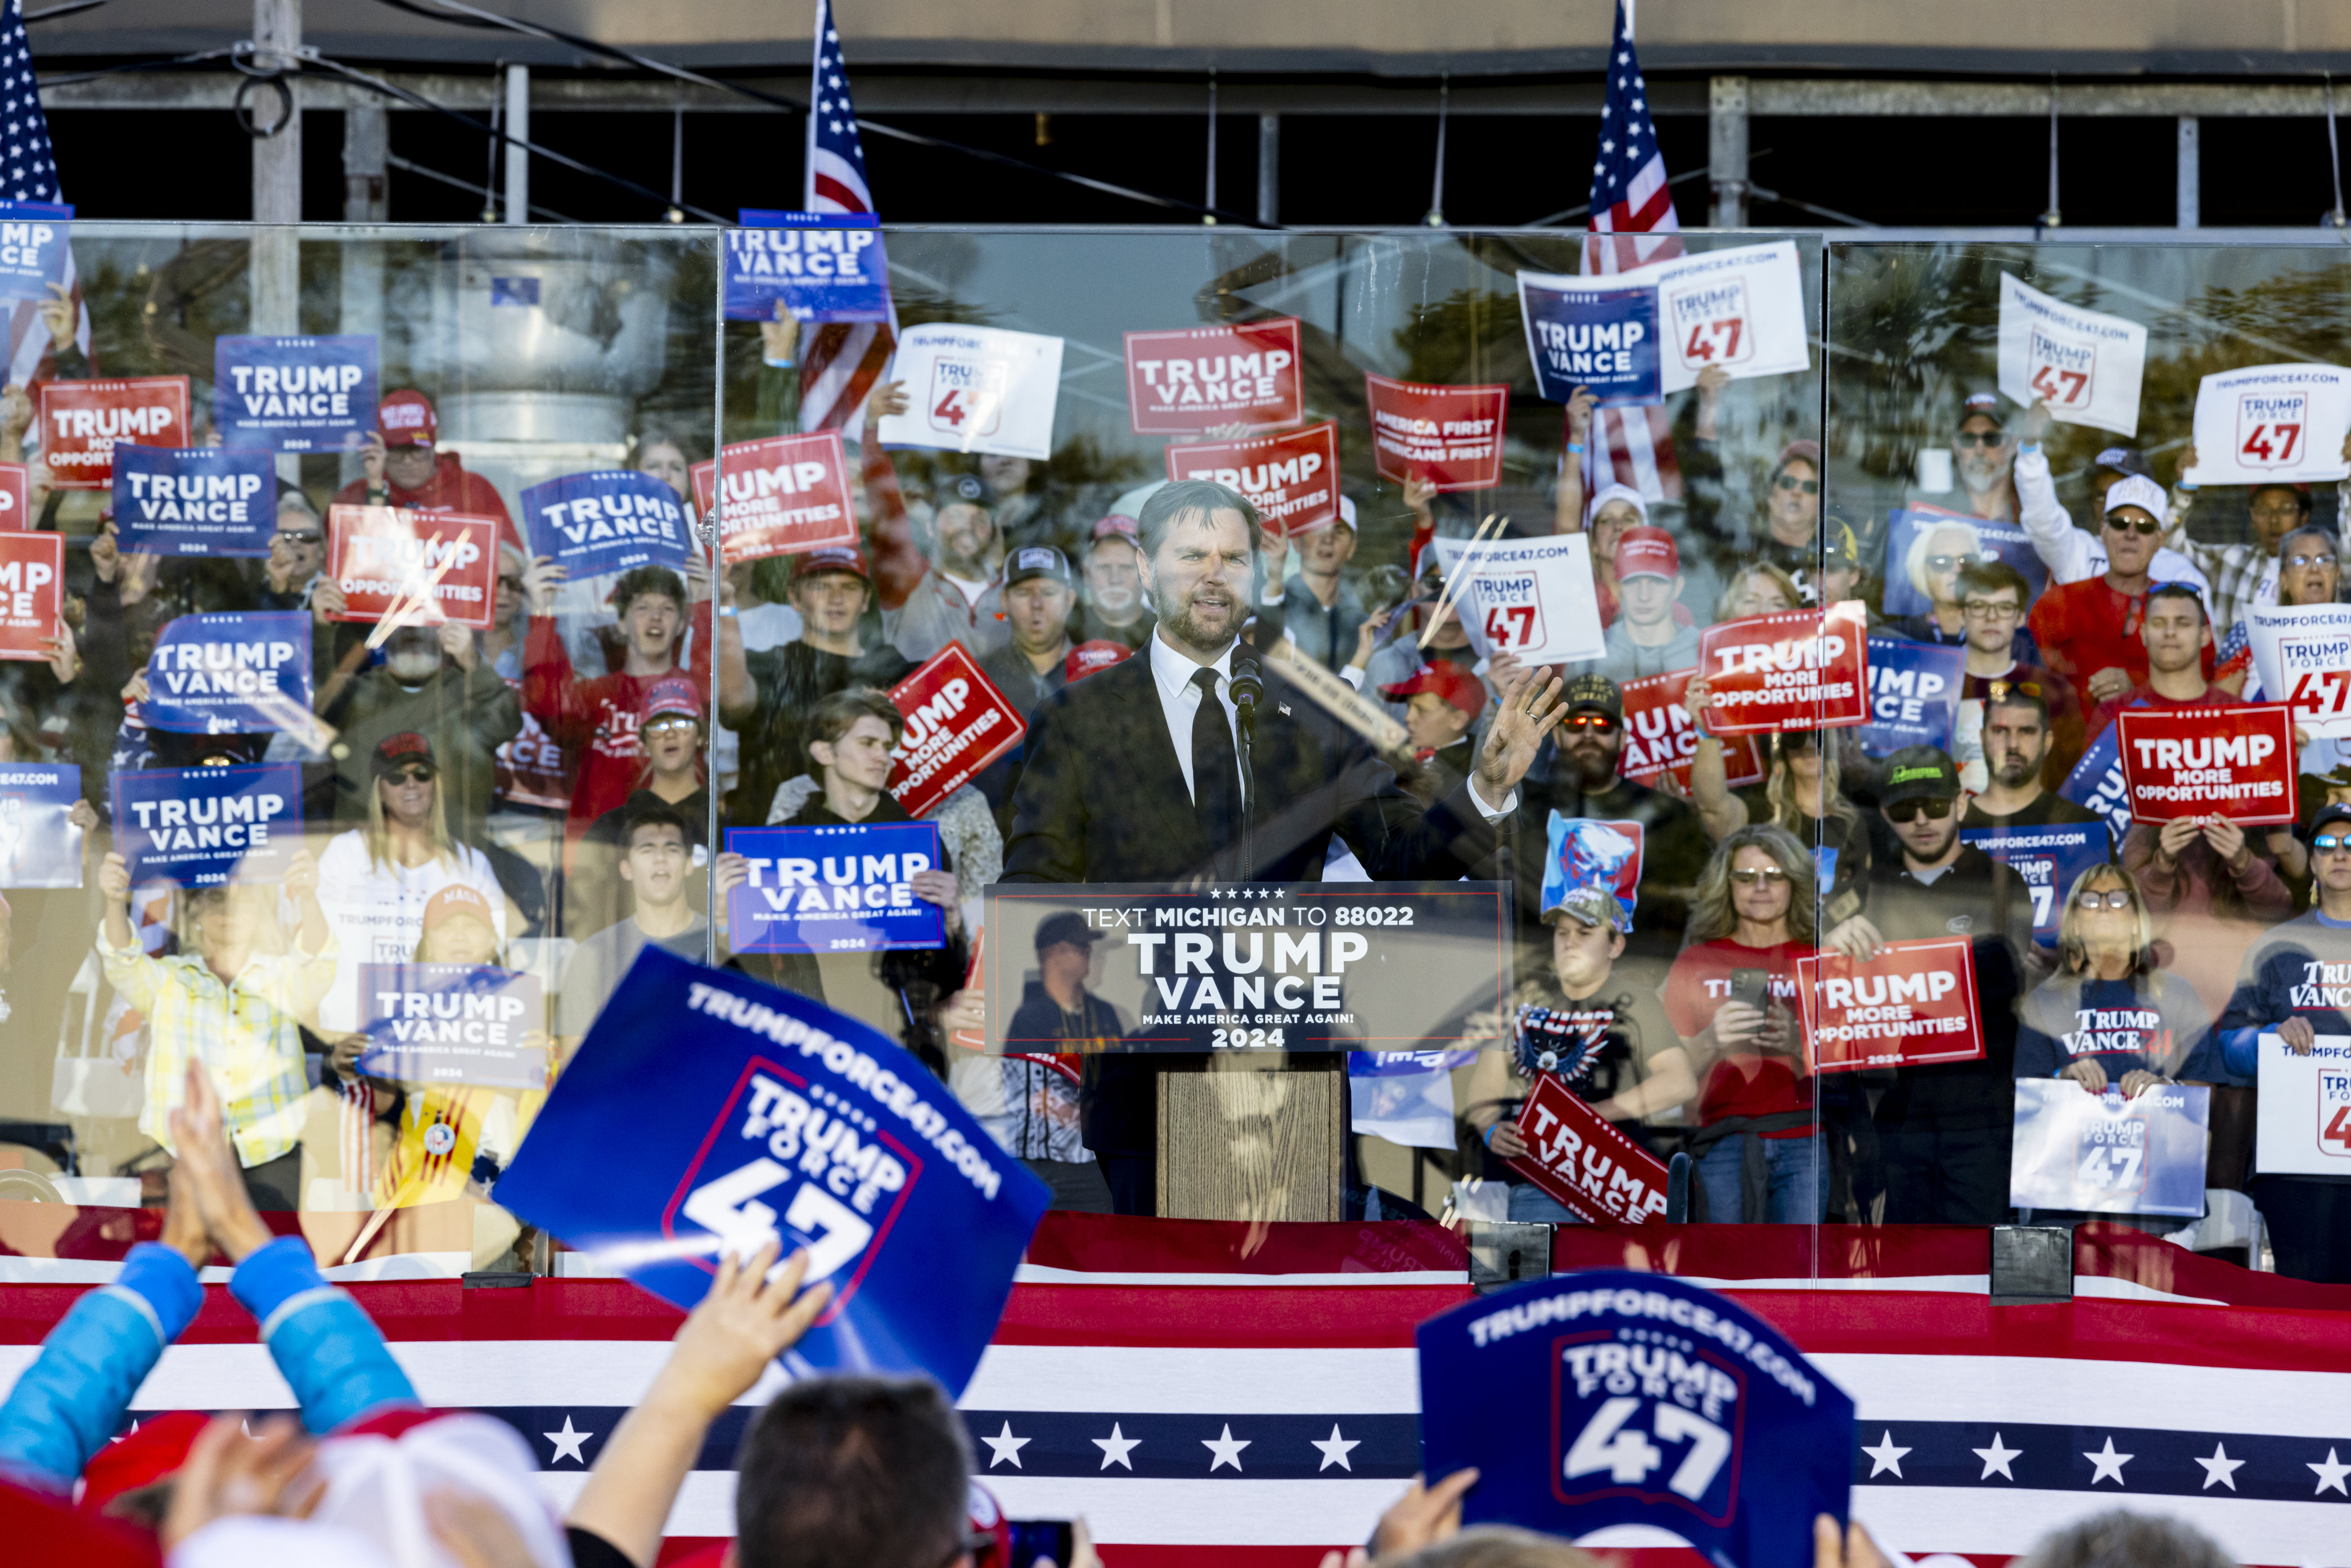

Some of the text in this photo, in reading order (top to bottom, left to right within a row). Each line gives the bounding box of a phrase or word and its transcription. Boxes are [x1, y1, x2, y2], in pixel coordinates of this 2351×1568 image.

[728, 229, 874, 253] TRUMP
[737, 252, 861, 275] VANCE
[1676, 284, 1740, 312] TRUMP
[1680, 301, 1737, 322] FORCE
[1535, 319, 1645, 353] TRUMP
[1687, 317, 1743, 361] 47
[2034, 333, 2092, 362] TRUMP
[1136, 350, 1292, 386] TRUMP
[1547, 349, 1632, 373] VANCE
[2035, 351, 2086, 369] FORCE
[231, 364, 363, 395] TRUMP
[1156, 377, 1276, 404] VANCE
[2030, 365, 2088, 403] 47
[244, 394, 349, 417] VANCE
[1177, 402, 1219, 412] AMERICA
[1222, 399, 1251, 410] GREAT
[1253, 395, 1285, 407] AGAIN!
[2244, 396, 2303, 412] TRUMP
[2246, 411, 2298, 421] FORCE
[52, 407, 173, 438] TRUMP
[1375, 409, 1495, 437] AMERICA FIRST
[1377, 435, 1493, 462] AMERICANS FIRST
[1406, 436, 1443, 448] MEANS
[2242, 423, 2302, 460] 47
[127, 472, 262, 501] TRUMP
[720, 461, 827, 503] RUMP
[1188, 452, 1322, 494] TRUMP
[139, 499, 249, 522] VANCE
[541, 494, 681, 528] TRUMP
[1244, 488, 1287, 508] ORE
[131, 522, 156, 530] MAKE
[156, 523, 195, 532] AMERICA
[226, 525, 257, 533] AGAIN!
[563, 516, 677, 544] VANCE
[720, 504, 841, 535] ORTUNITIES
[179, 542, 208, 553] 2024
[348, 536, 480, 570] TRUMP
[1447, 546, 1569, 563] TRUMPFORCE47.COM
[340, 578, 483, 602] OPPORNITIES
[1474, 578, 1533, 593] TRUMP
[1481, 591, 1529, 602] FORCE
[1486, 606, 1535, 647] 47
[2253, 614, 2351, 627] TRUMPFORCE47.
[154, 641, 294, 671] TRUMP
[2284, 642, 2349, 658] TRUMP
[2290, 656, 2345, 668] FORCE
[165, 670, 279, 694] VANCE
[1765, 670, 1818, 688] MORE
[1868, 666, 1945, 699] UMP
[2289, 670, 2351, 714] 47
[183, 697, 224, 706] AMERICA
[890, 677, 970, 760] UMP
[1622, 703, 1690, 744] RUM
[1782, 717, 1812, 728] 2024
[890, 708, 1002, 802] PPORTUNITIES
[905, 726, 954, 771] MORE
[1624, 735, 1699, 768] ANC
[2133, 735, 2276, 769] TRUMP
[942, 769, 970, 794] 2024
[1624, 763, 1667, 779] AMERICA
[2174, 768, 2232, 785] MORE
[2136, 781, 2284, 802] OPPORTUNITIES
[131, 794, 285, 829] TRUMP
[148, 823, 269, 851] VANCE
[1961, 832, 2086, 849] UMPFORCE47.COM
[142, 855, 168, 864] MAKE
[169, 852, 210, 863] AMERICA
[213, 850, 244, 860] GREAT
[746, 852, 930, 889] TRUMP
[2012, 860, 2053, 875] UMP
[195, 872, 227, 884] 2024
[761, 882, 913, 912] VANCE
[2029, 885, 2054, 927] 7
[753, 908, 922, 921] MAKE AMERICA GREAT AGAIN!
[1083, 906, 1413, 928] TEXT MICHIGAN TO 88022
[830, 938, 866, 950] 2024
[1128, 932, 1368, 974] TRUMP
[2304, 959, 2351, 985] TRU
[1155, 976, 1341, 1010] VANCE
[2289, 983, 2351, 1007] VANC
[376, 992, 525, 1022] TRUMP
[1143, 1013, 1354, 1024] MAKE AMERICA GREAT AGAIN!
[1846, 1004, 1913, 1024] MORE
[2075, 1008, 2160, 1031] TRUMP
[391, 1020, 509, 1046] VANCE
[1211, 1028, 1285, 1048] 2024
[2061, 1030, 2141, 1054] VANCE
[1867, 1053, 1904, 1065] 2024
[686, 982, 1002, 1201] TRUMPFORCE47.COM
[745, 1073, 908, 1192] TRUMP
[2084, 1121, 2145, 1135] TRUMP
[2084, 1133, 2138, 1146] FORCE
[741, 1115, 880, 1214] FORCE
[1532, 1103, 1668, 1216] TRUMP
[2077, 1146, 2143, 1189] 47
[1524, 1152, 1616, 1216] MAKE AMERICA GREAT
[1539, 1138, 1649, 1224] VANCE
[682, 1156, 874, 1287] 47
[1567, 1201, 1596, 1224] 2024
[1467, 1288, 1816, 1407] TRUMPFORCE47.COM
[1562, 1342, 1739, 1404] TRUMP
[1578, 1372, 1723, 1423] FORCE
[1564, 1396, 1732, 1502] 47
